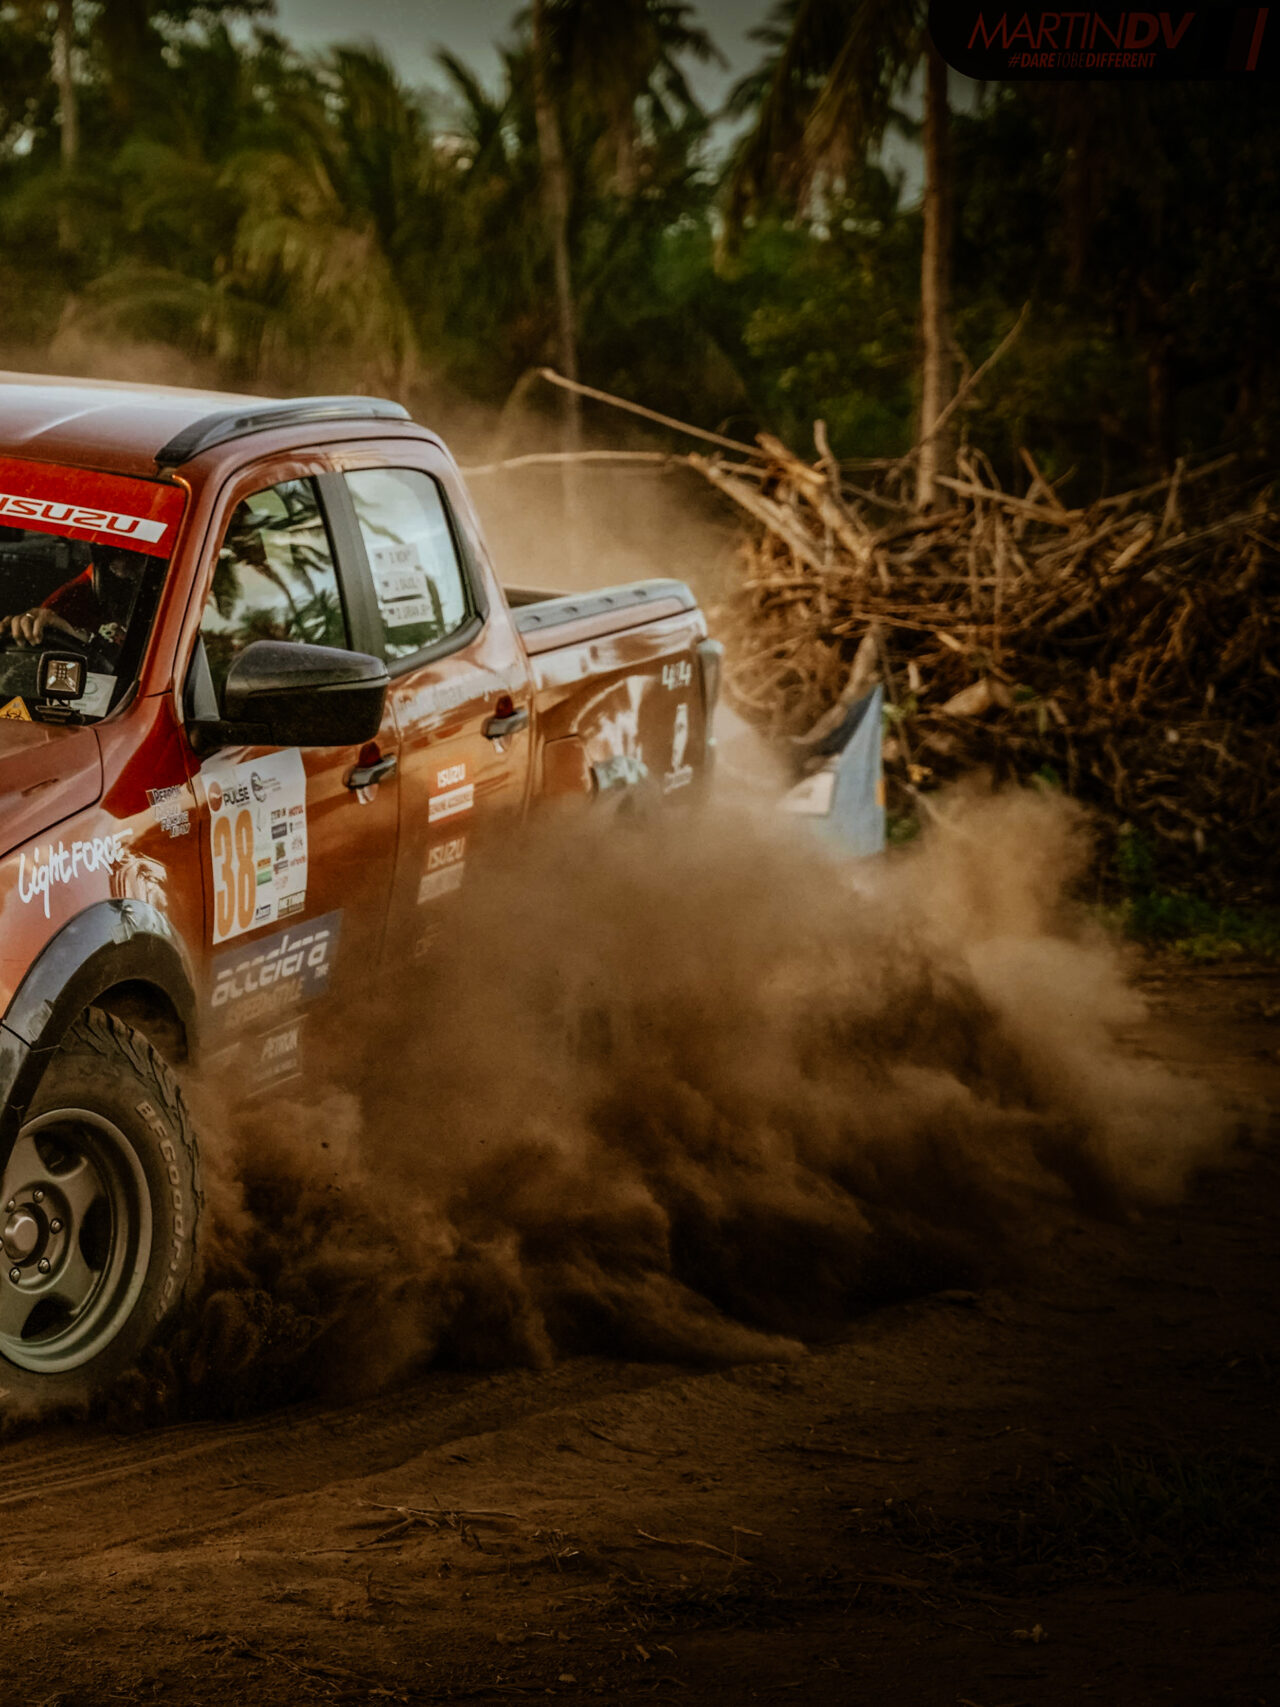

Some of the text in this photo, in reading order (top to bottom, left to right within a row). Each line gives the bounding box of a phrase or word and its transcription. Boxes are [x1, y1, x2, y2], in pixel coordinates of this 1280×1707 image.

[437, 763, 466, 788] ISUZU
[428, 837, 466, 870] ISUZU
[213, 809, 257, 938] 38
